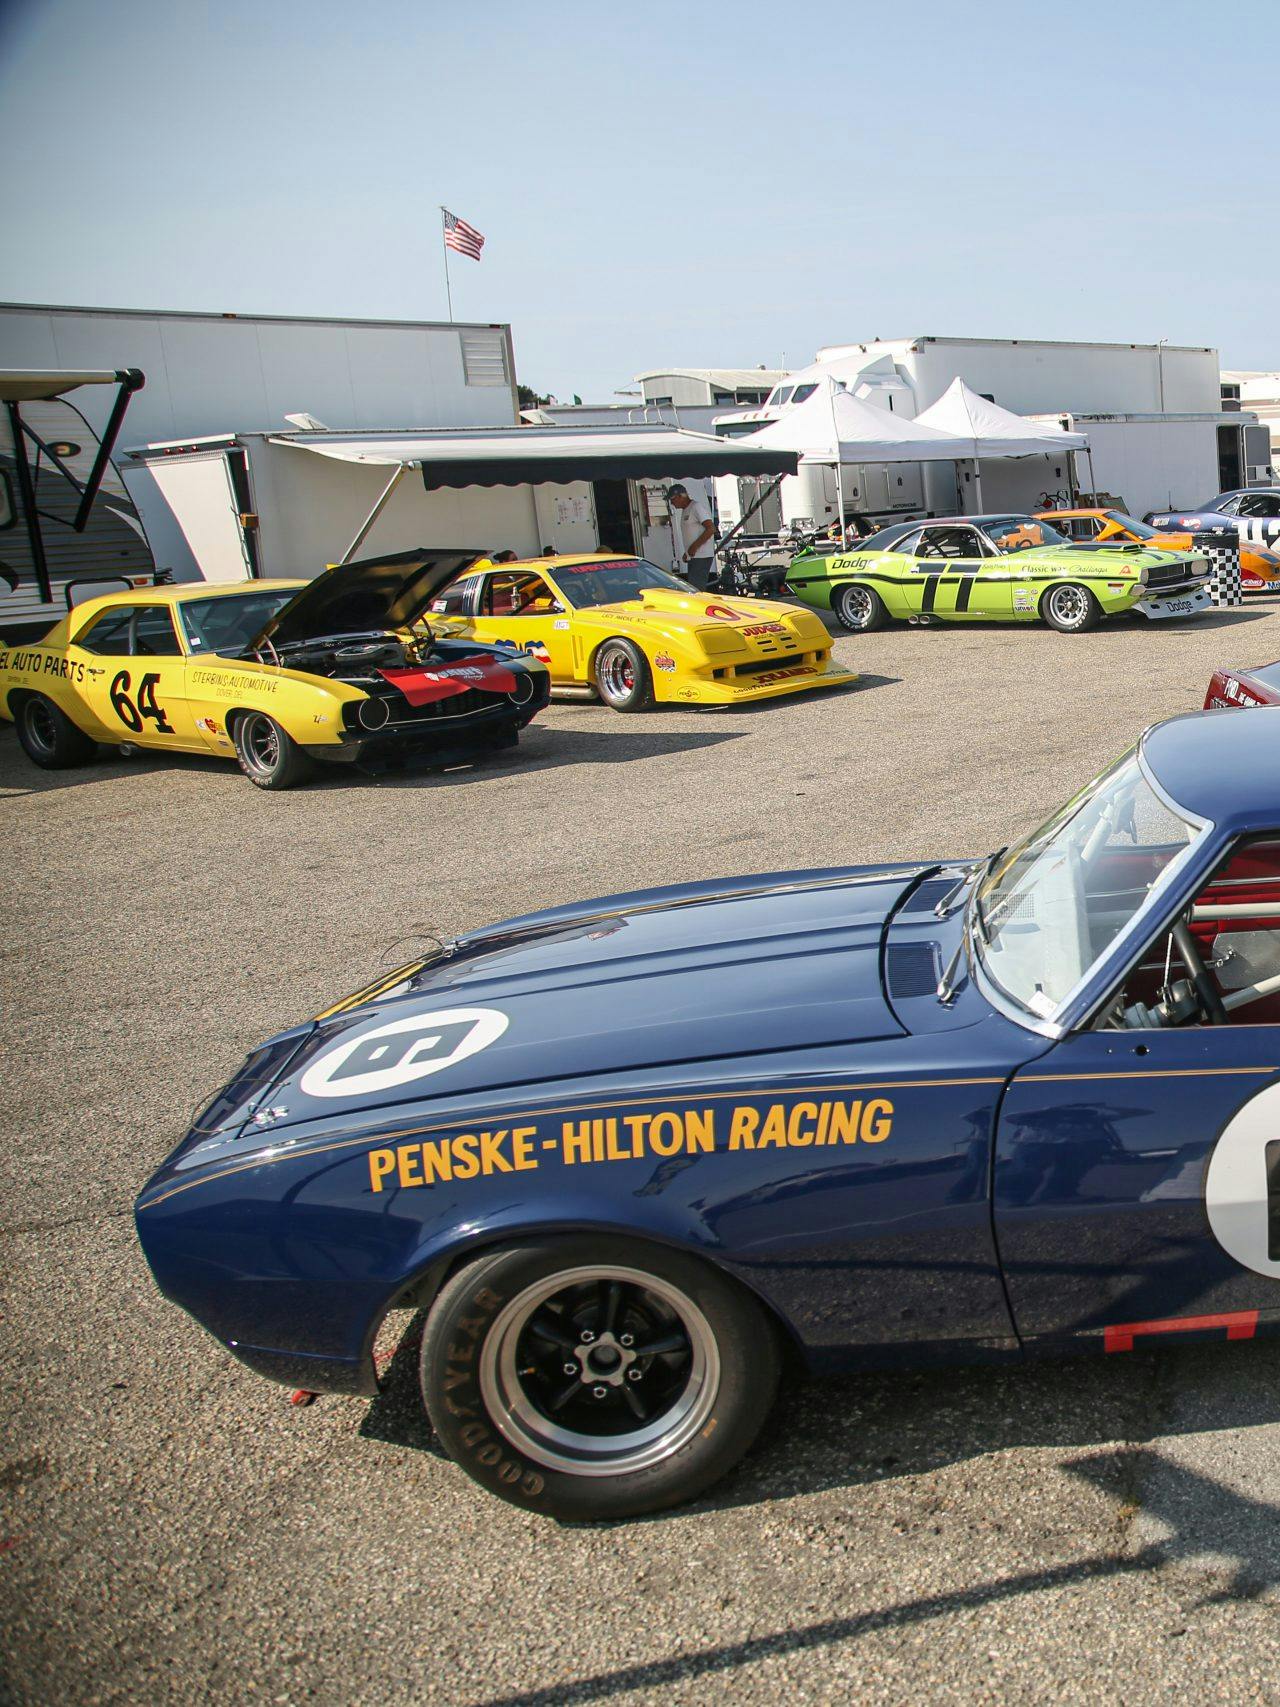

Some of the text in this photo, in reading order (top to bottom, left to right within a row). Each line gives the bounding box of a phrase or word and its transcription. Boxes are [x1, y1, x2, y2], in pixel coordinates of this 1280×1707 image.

[1021, 564, 1049, 574] Classic
[1165, 600, 1194, 613] Dodge
[12, 652, 42, 673] AUTO
[44, 655, 86, 683] PARTS
[110, 669, 177, 735] 64
[326, 1019, 481, 1083] 6
[727, 1098, 895, 1151] RACING
[443, 1286, 545, 1496] GOODYEAR
